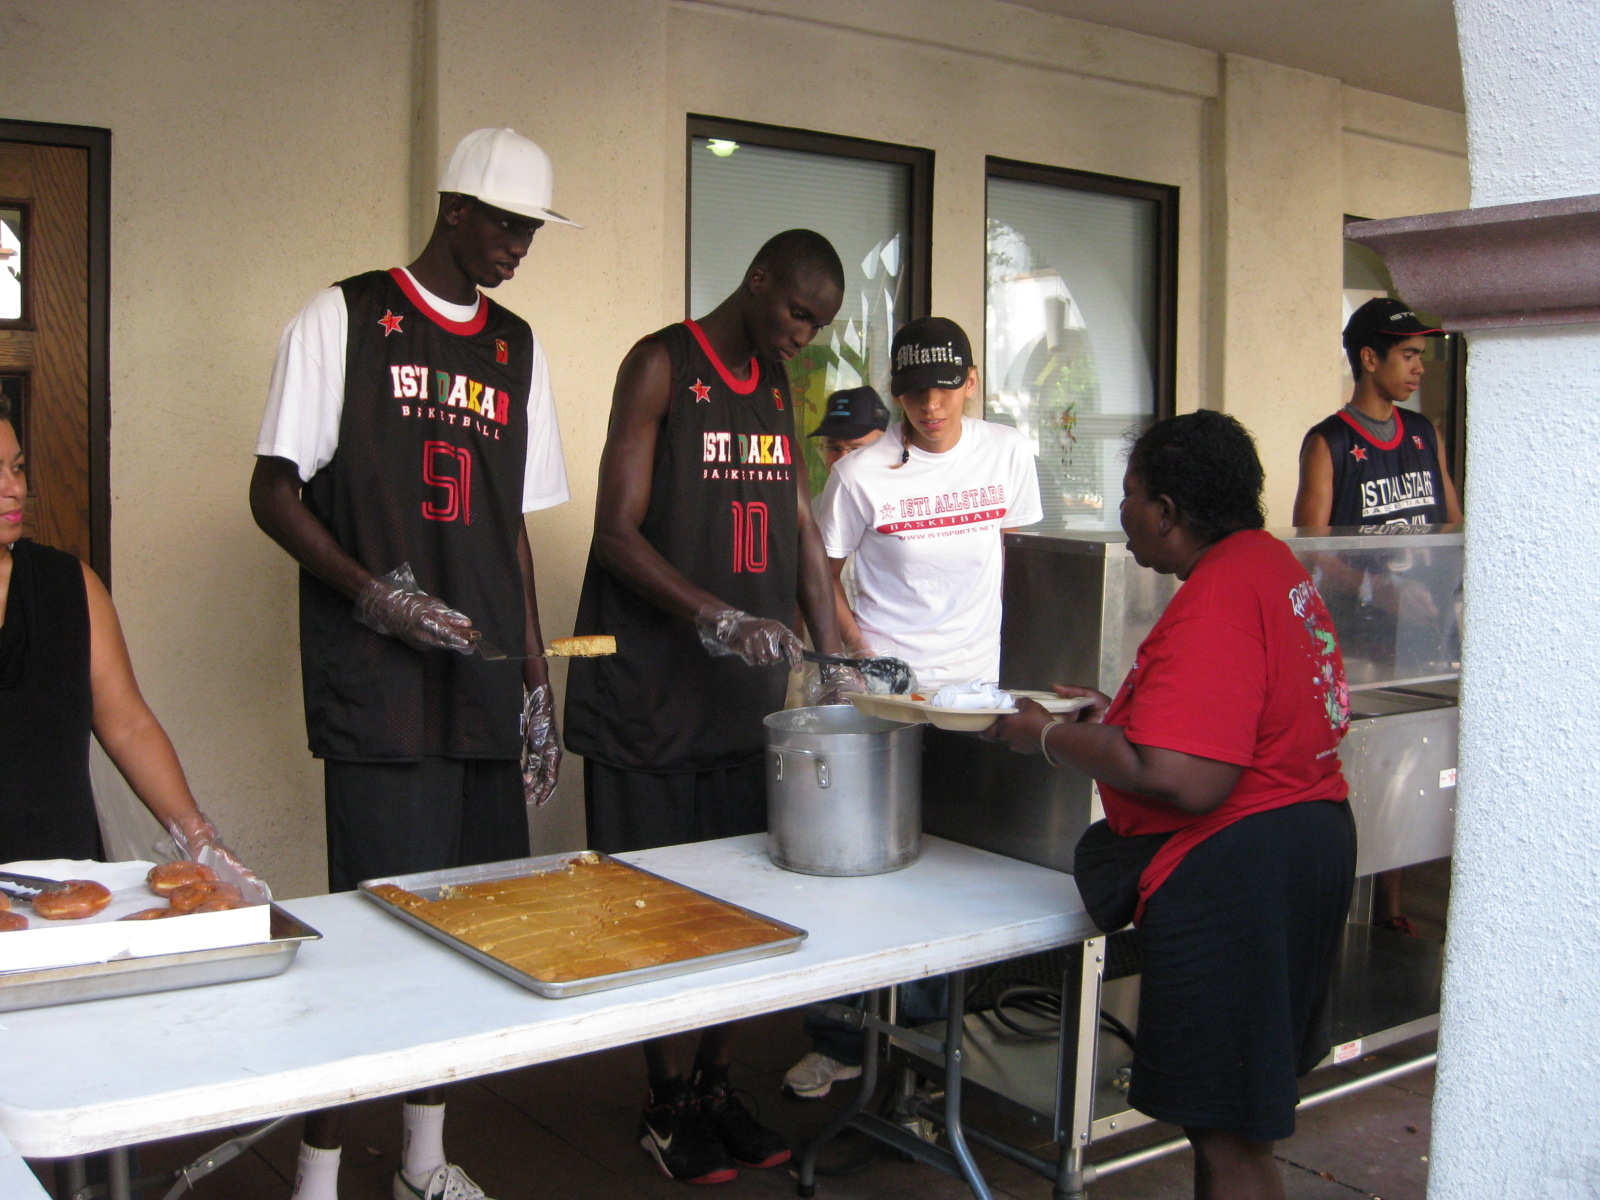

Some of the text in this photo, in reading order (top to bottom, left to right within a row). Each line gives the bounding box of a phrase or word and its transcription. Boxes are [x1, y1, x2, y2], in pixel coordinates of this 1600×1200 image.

[896, 341, 953, 370] Miami
[436, 369, 509, 425] DAKAR
[738, 433, 792, 465] DAKAR
[422, 441, 471, 525] 51
[900, 485, 1006, 518] ISTI ALLSTARS
[890, 509, 1000, 531] BASKETBALL
[731, 501, 768, 573] 10
